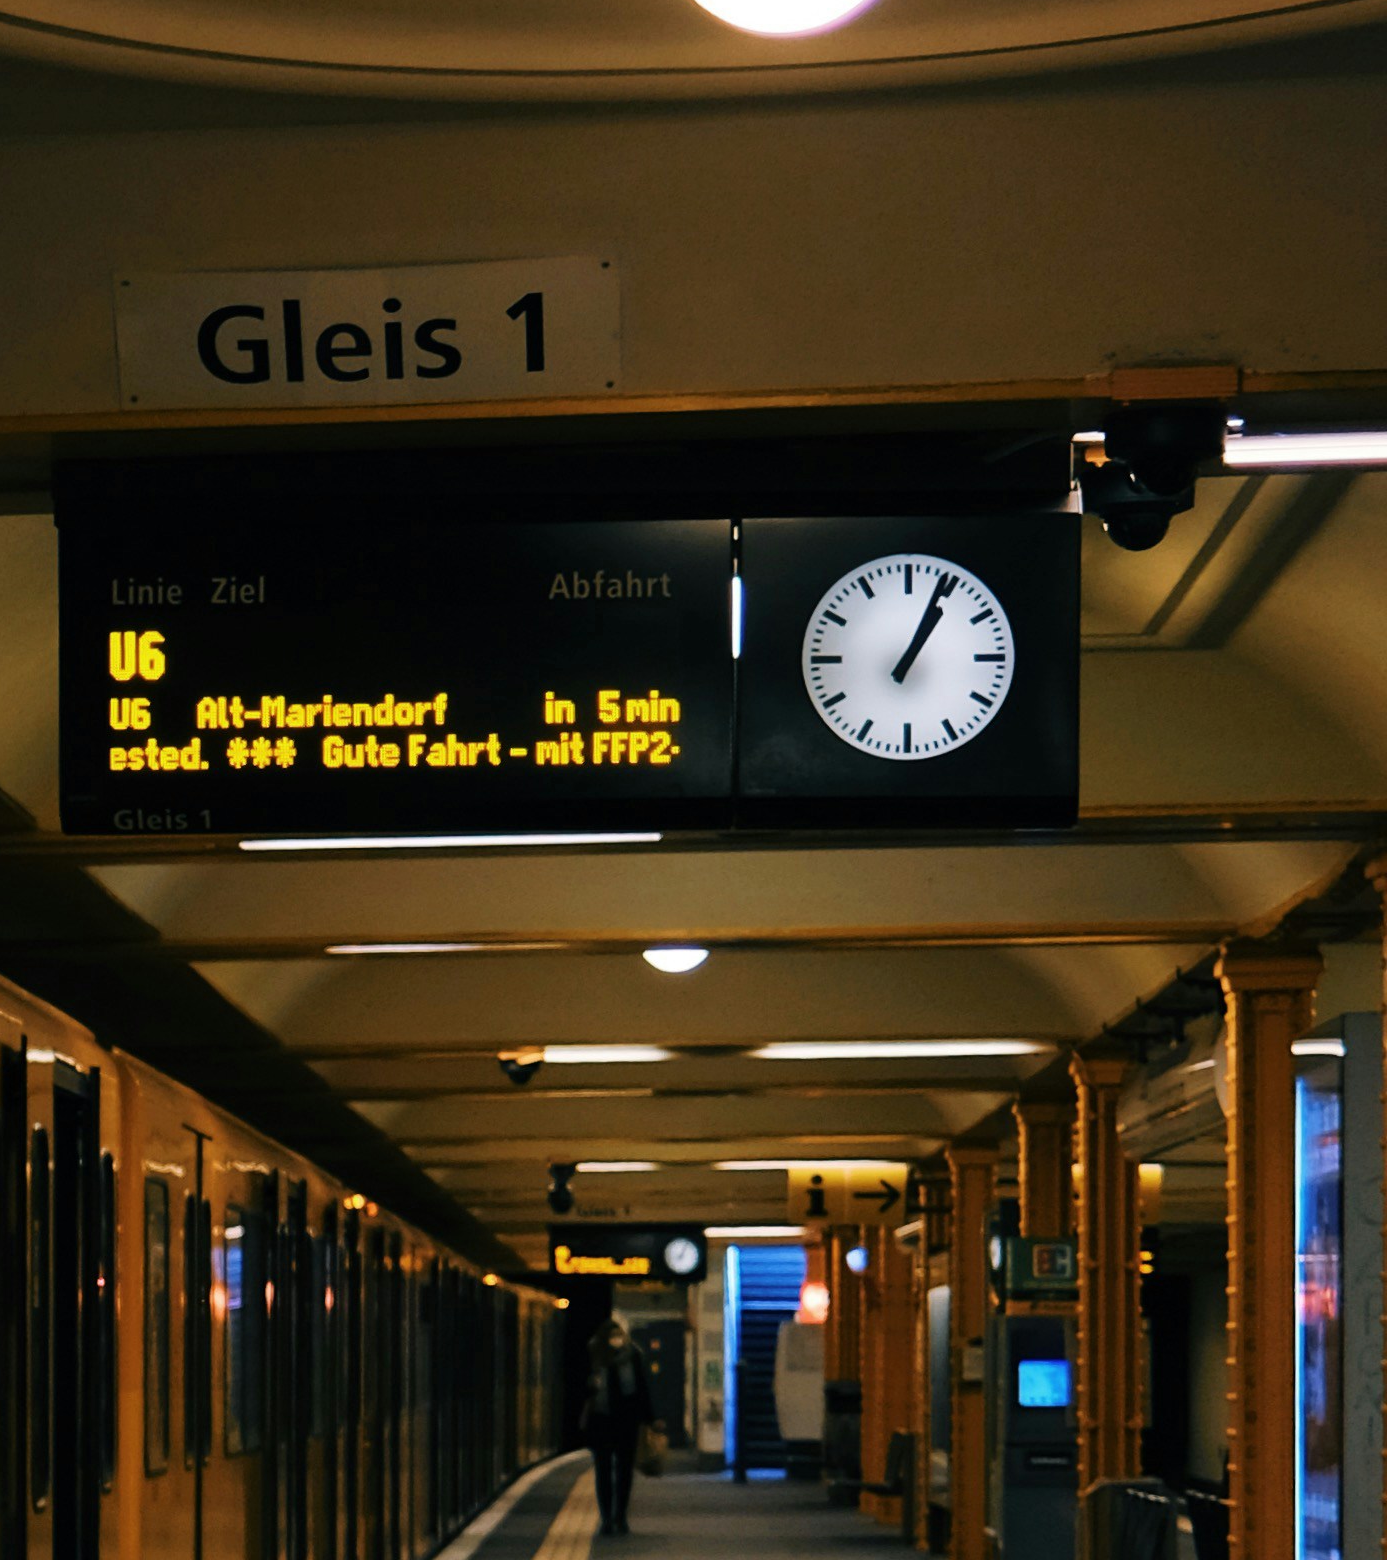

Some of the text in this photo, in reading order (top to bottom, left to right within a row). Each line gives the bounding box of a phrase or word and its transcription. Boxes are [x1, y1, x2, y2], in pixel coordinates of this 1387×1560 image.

[197, 292, 545, 384] Gleis 1
[111, 569, 672, 606] Linie Ziel Abfahrt
[110, 631, 166, 681] U6
[109, 689, 681, 731] U6 Alt-Mariendorf in 5 min
[322, 734, 401, 769] Gute
[408, 732, 502, 767] Fahrt
[535, 731, 585, 766] mit
[113, 808, 211, 831] Gleis 1
